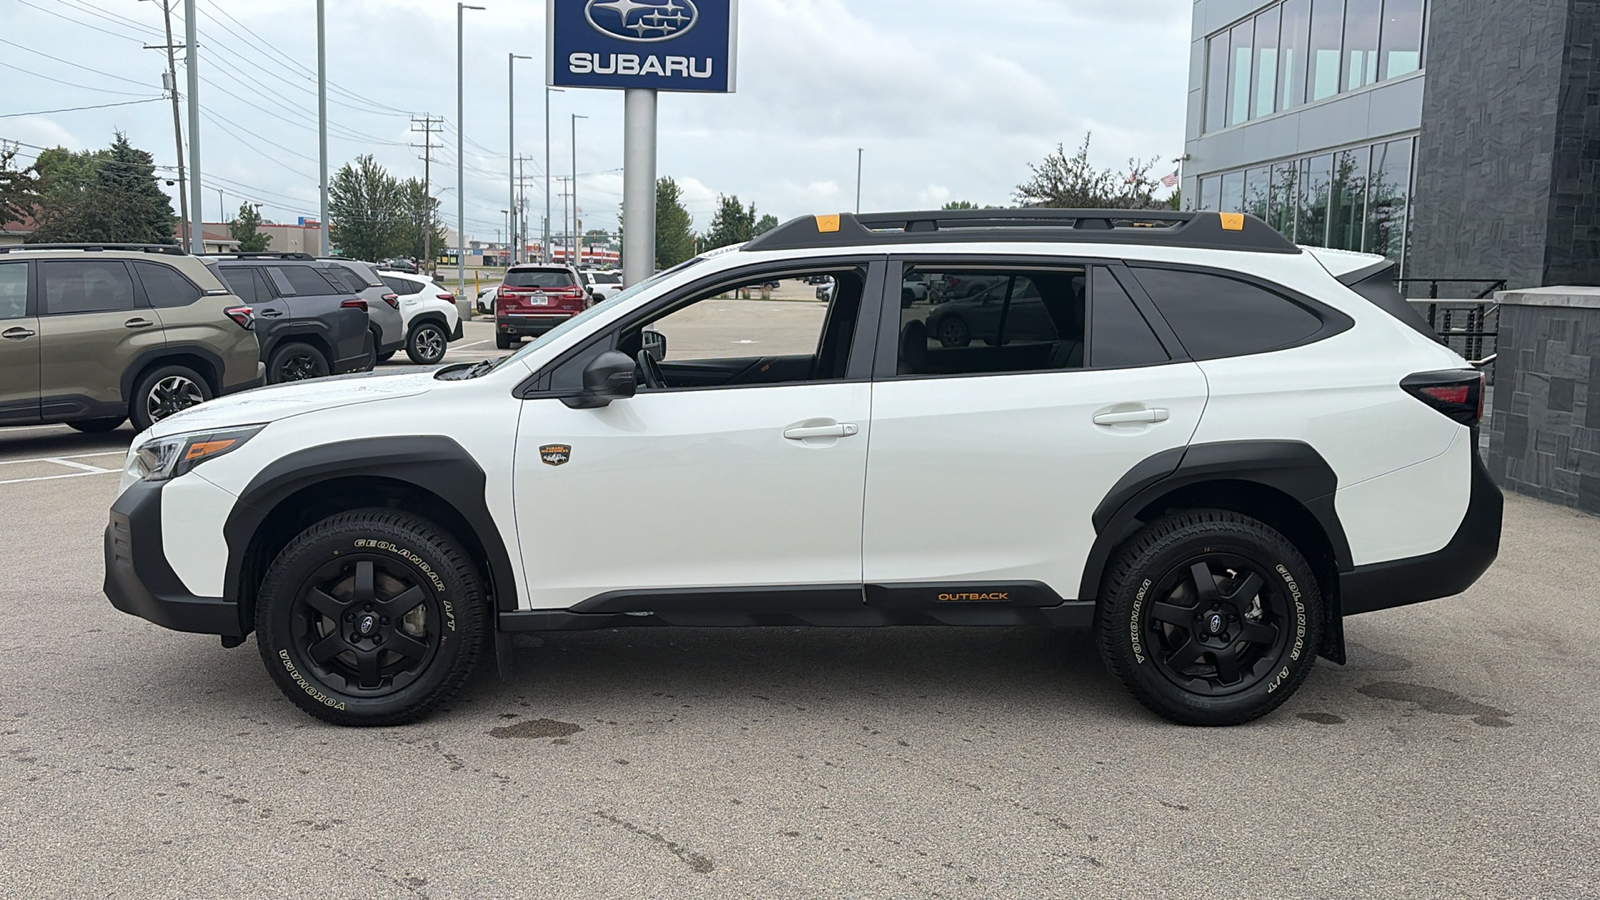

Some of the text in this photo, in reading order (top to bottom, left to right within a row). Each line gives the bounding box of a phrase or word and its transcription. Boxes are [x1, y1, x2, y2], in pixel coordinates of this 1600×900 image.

[569, 52, 713, 78] SUBARU
[354, 539, 455, 631] GEOLANDAR A/T
[938, 592, 1009, 601] OUTBACK
[1130, 578, 1152, 664] YOKOHAMA
[1267, 564, 1306, 693] GEOLANDAR A/T
[279, 649, 346, 710] YOKOHAMA
